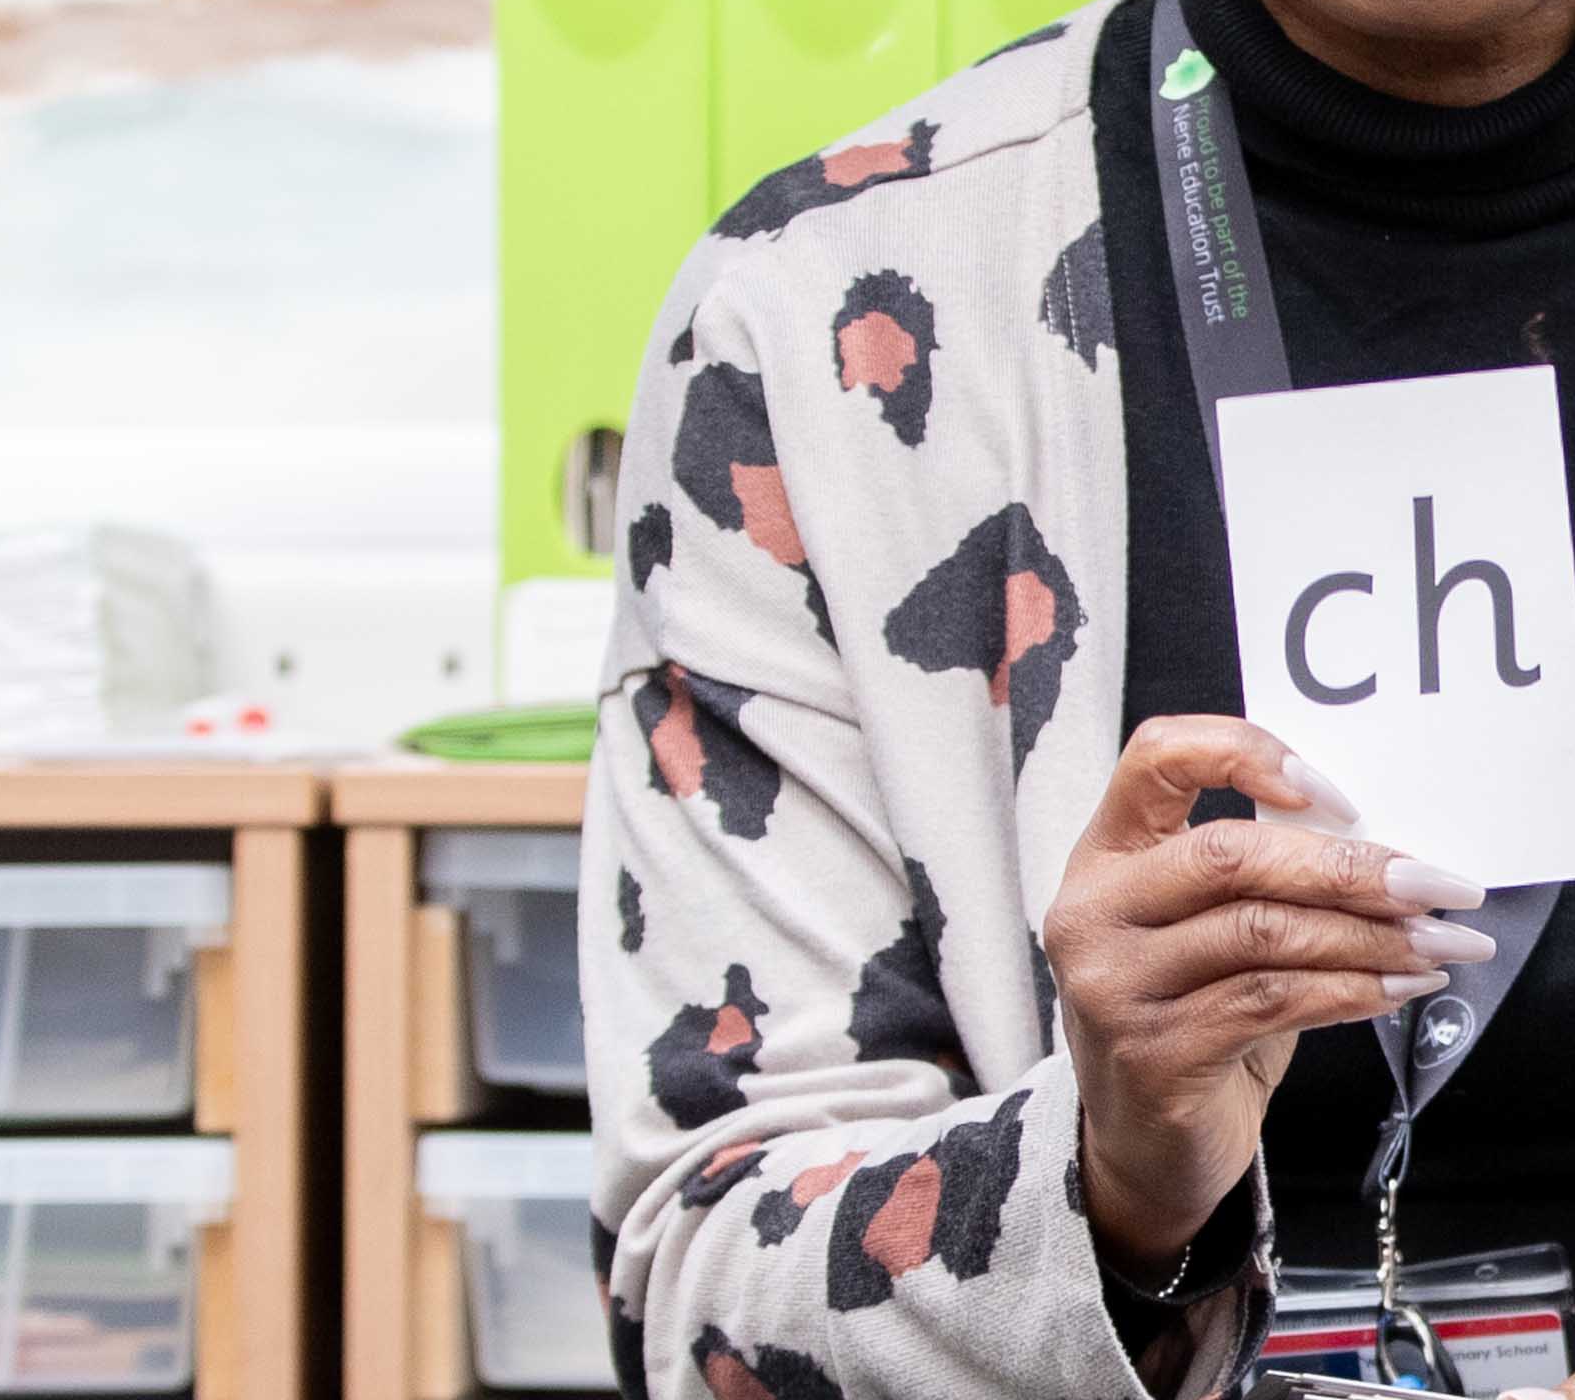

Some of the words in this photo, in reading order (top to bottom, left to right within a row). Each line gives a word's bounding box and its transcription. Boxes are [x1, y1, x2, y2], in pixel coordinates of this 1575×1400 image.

[1172, 102, 1193, 160] Nene
[1195, 95, 1218, 155] Proud
[1203, 157, 1218, 179] to
[1179, 161, 1212, 266] Education
[1207, 182, 1226, 209] be
[1209, 213, 1236, 256] part
[1223, 259, 1245, 281] of
[1198, 267, 1225, 327] Trust
[1227, 284, 1250, 319] the
[1284, 495, 1542, 706] ch
[1496, 1343, 1549, 1359] School
